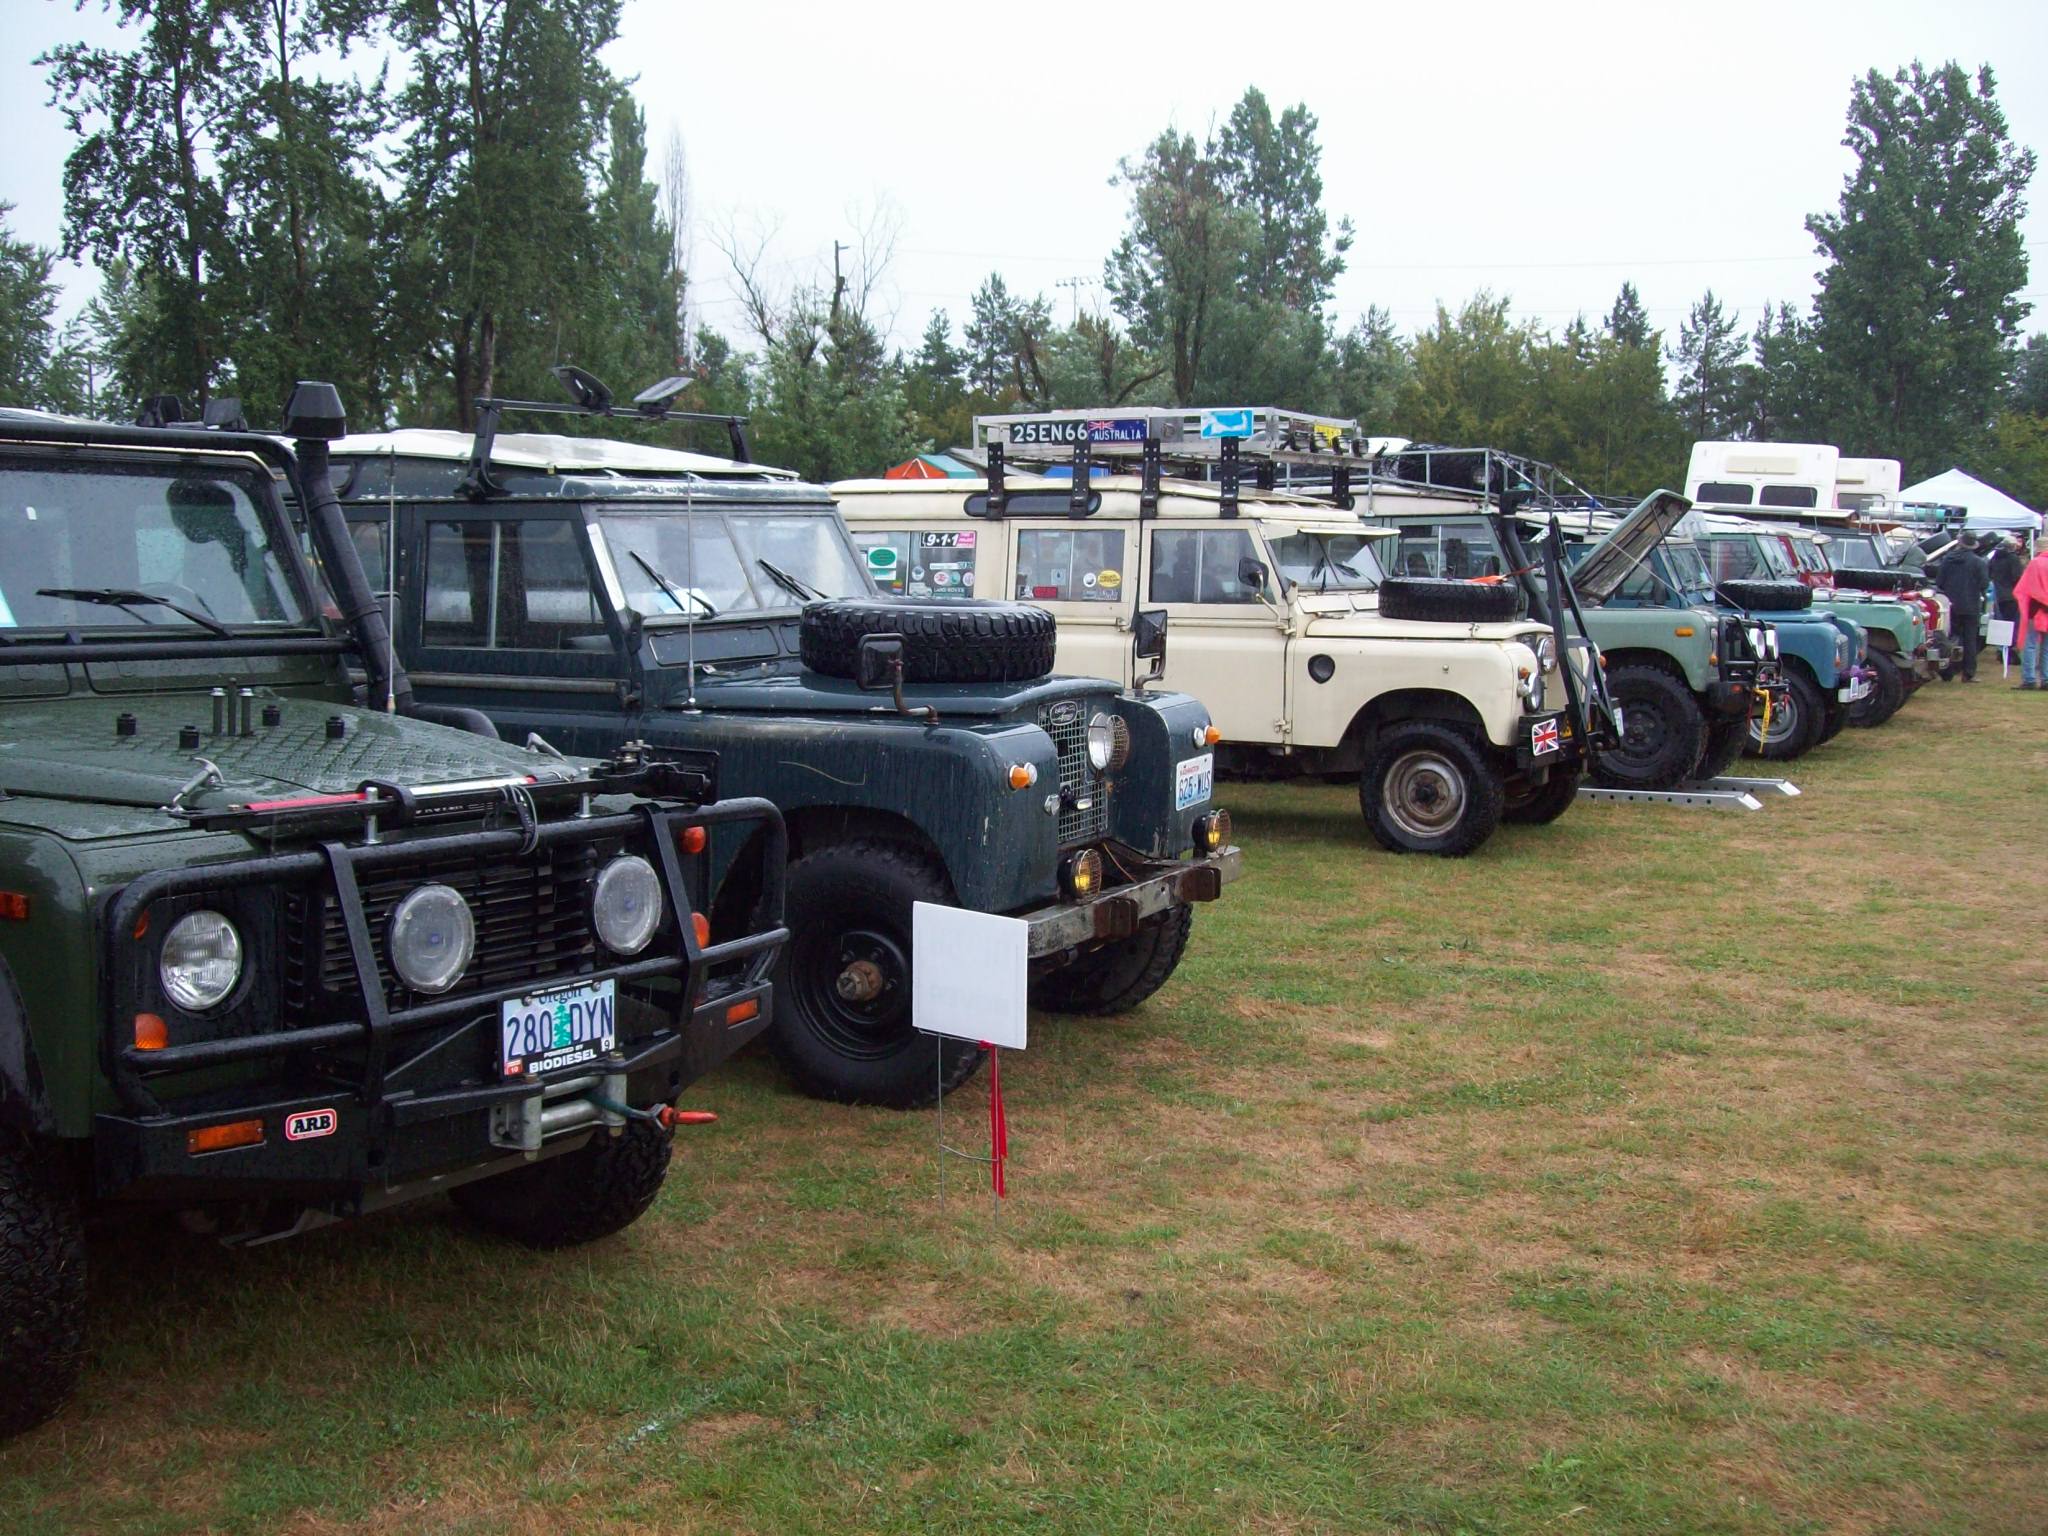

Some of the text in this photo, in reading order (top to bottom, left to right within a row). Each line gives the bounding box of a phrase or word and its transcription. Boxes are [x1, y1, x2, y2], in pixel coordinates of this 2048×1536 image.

[1013, 422, 1087, 442] 25EN66
[1093, 428, 1142, 441] AUSTRALIA
[506, 995, 613, 1061] 280 DYN
[603, 1040, 611, 1051] 9
[510, 1065, 519, 1073] 10
[529, 1048, 598, 1073] BIODIESEL
[293, 1115, 331, 1134] ARB
